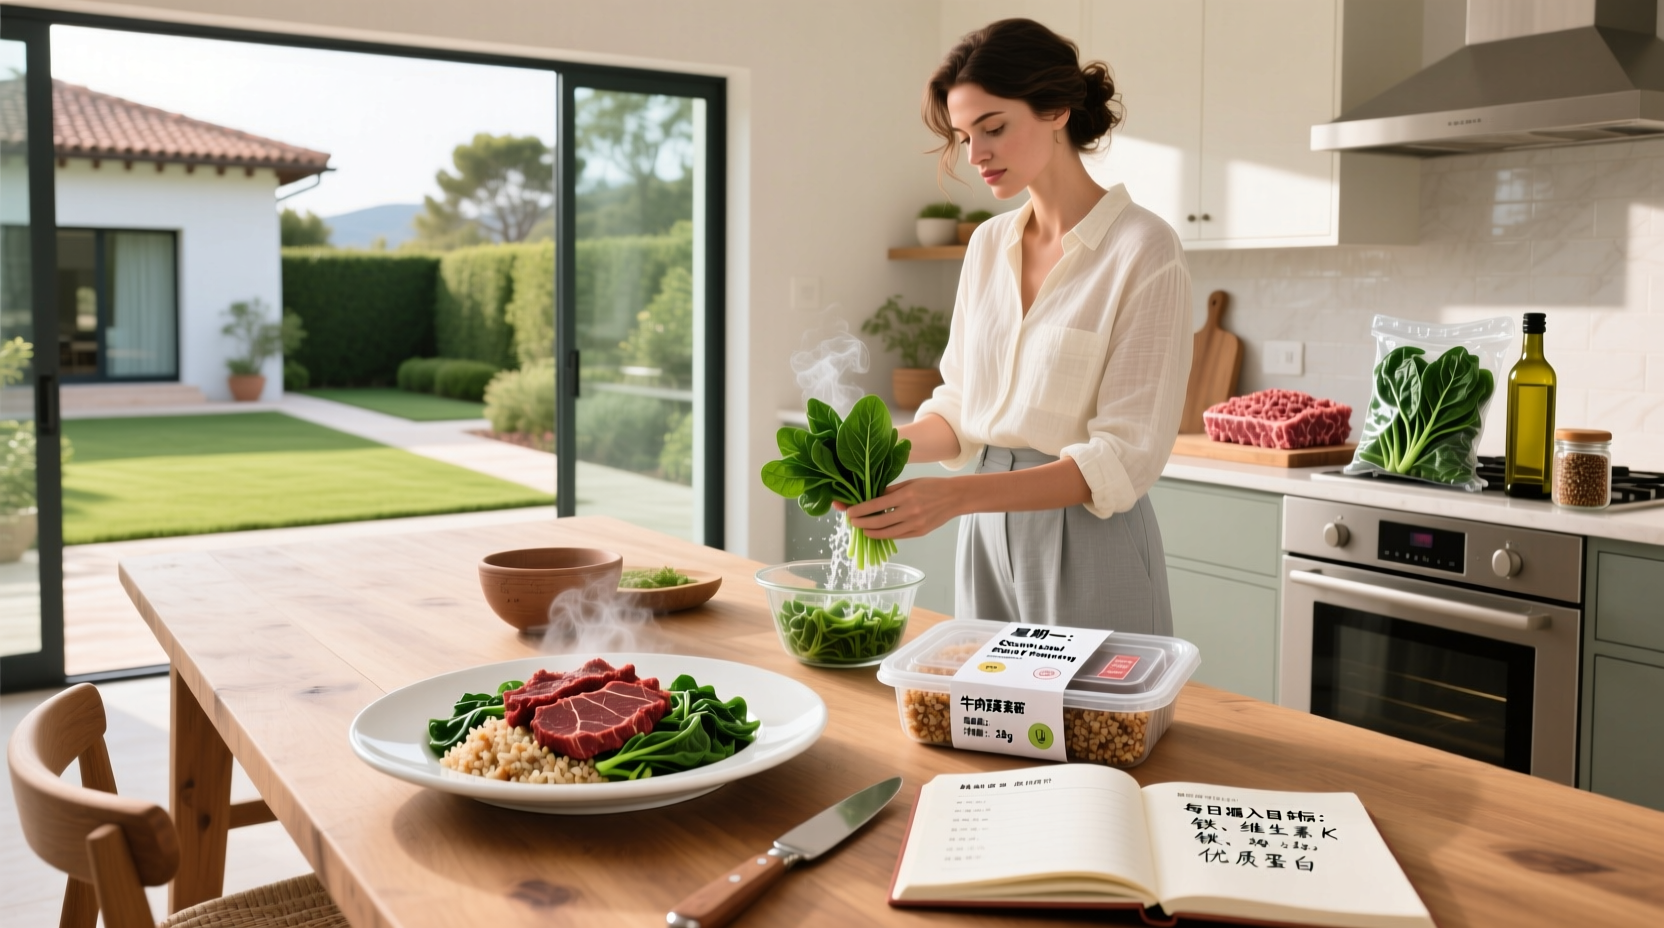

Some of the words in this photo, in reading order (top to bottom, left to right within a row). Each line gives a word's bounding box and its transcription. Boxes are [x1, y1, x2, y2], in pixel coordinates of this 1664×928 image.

[1321, 826, 1339, 840] K
[1198, 847, 1314, 872] 优质蛋白
